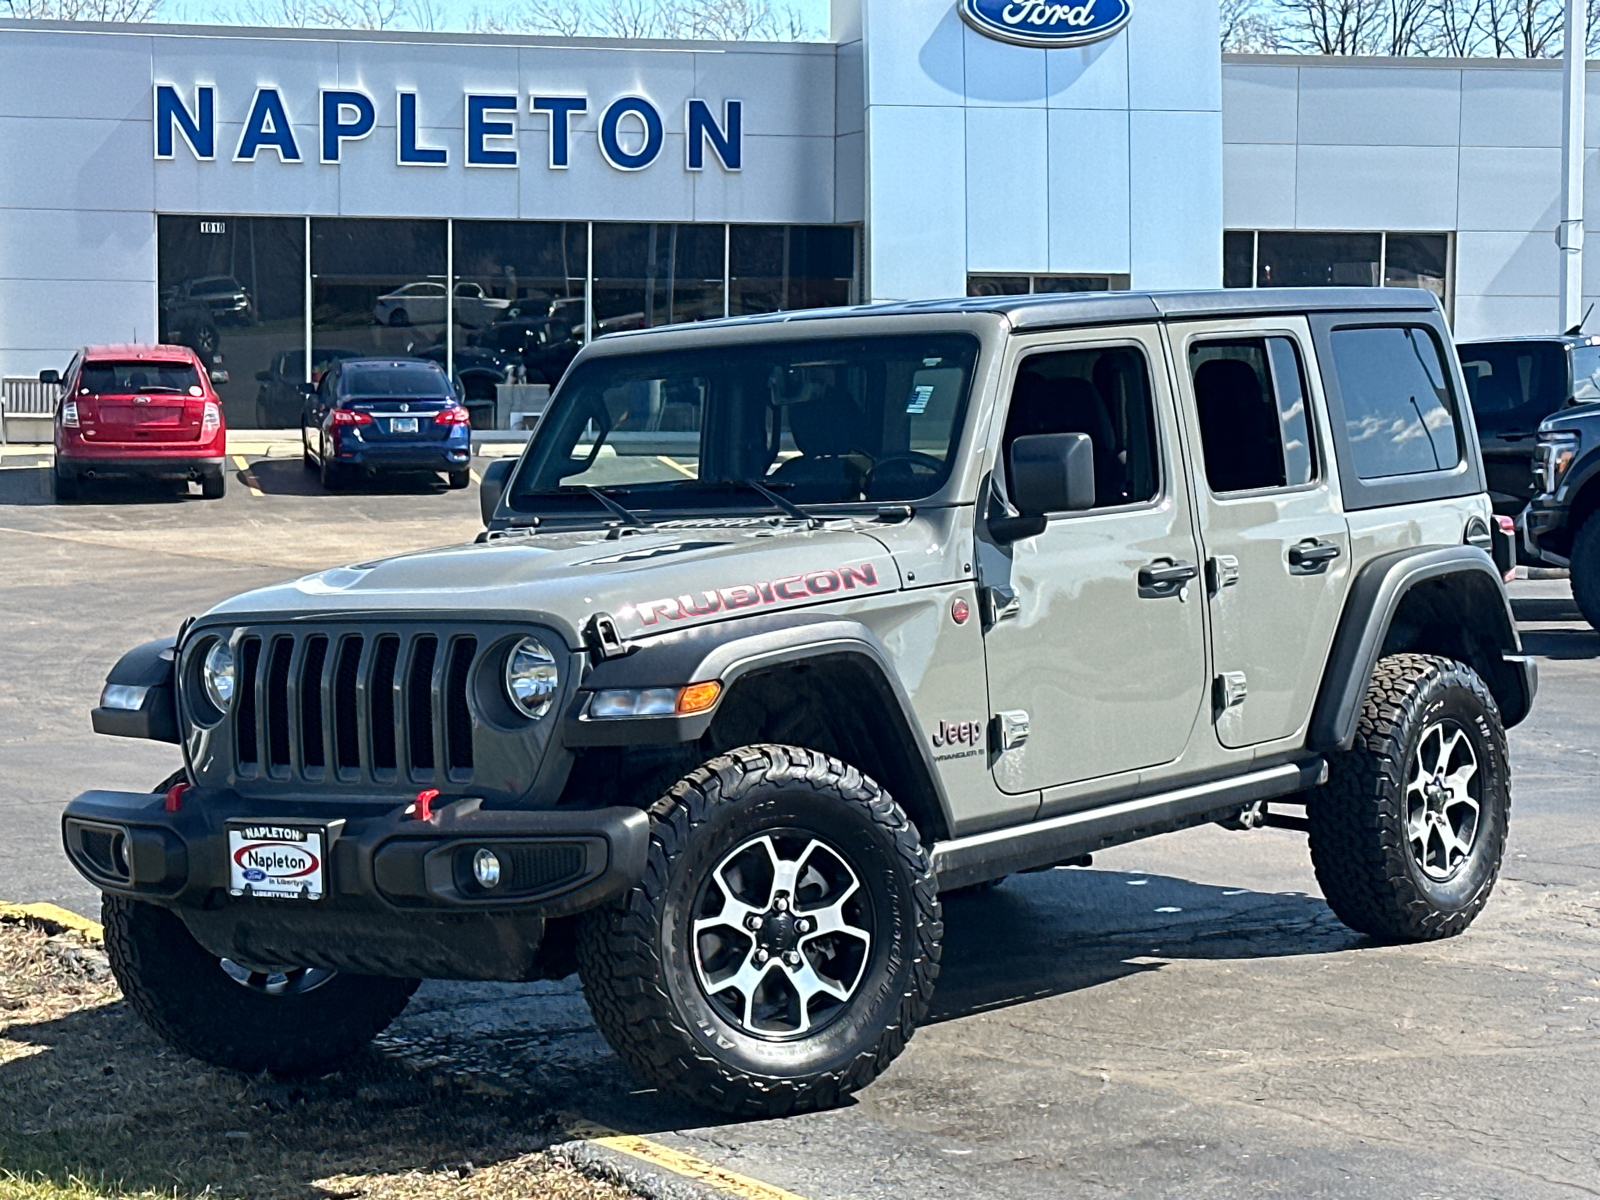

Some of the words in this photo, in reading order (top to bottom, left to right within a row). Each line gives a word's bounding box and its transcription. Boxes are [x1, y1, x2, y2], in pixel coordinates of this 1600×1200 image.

[1002, 0, 1095, 26] Ford
[153, 83, 743, 172] NAPLETON
[201, 221, 225, 233] 1010
[636, 563, 878, 626] RUBICON
[932, 719, 982, 747] Jeep
[933, 750, 977, 762] WRANGLER
[245, 827, 300, 840] NAPLETON
[248, 850, 306, 871] Napleton
